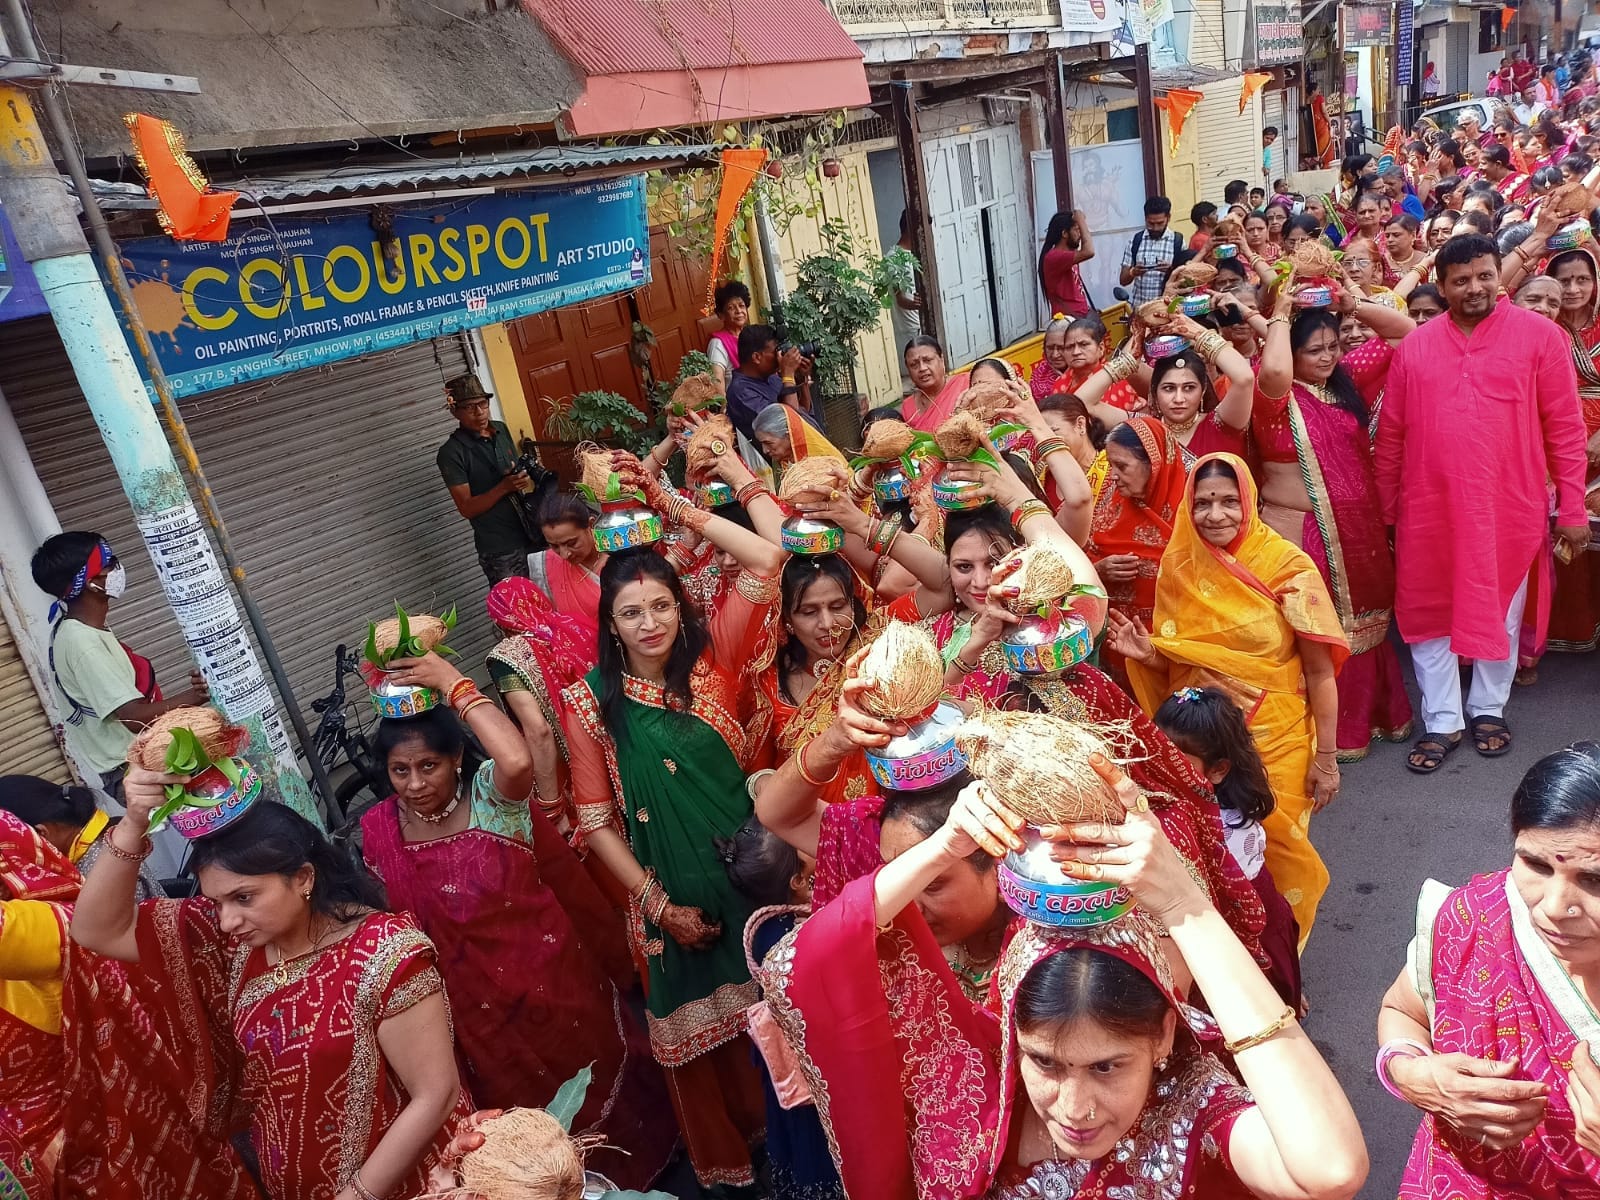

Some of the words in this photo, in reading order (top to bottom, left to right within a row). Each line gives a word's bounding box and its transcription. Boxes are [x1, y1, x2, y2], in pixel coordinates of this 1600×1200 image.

[182, 242, 211, 253] ARTIST
[246, 233, 272, 244] SINGH
[220, 248, 248, 259] MOHIT
[249, 244, 274, 255] SINGH
[556, 246, 584, 268] ART
[586, 237, 635, 260] STUDIO
[181, 212, 550, 330] COLOURSPOT
[607, 264, 621, 274] ESTD
[194, 344, 217, 360] OIL
[219, 331, 282, 356] PAINTING,
[284, 317, 342, 340] PORTRITS,
[343, 311, 377, 328] ROYAL
[379, 302, 415, 320] FRAME
[416, 299, 426, 312] &
[427, 292, 459, 310] PENCIL
[521, 270, 559, 289] PAINTING
[468, 299, 486, 310] 177
[193, 371, 213, 385] 177
[230, 358, 272, 376] SANGHI
[273, 349, 312, 368] STREET,
[314, 340, 352, 357] MHOW,
[375, 325, 414, 342] (453441)
[499, 303, 518, 313] RAM
[893, 748, 956, 781] मंगल
